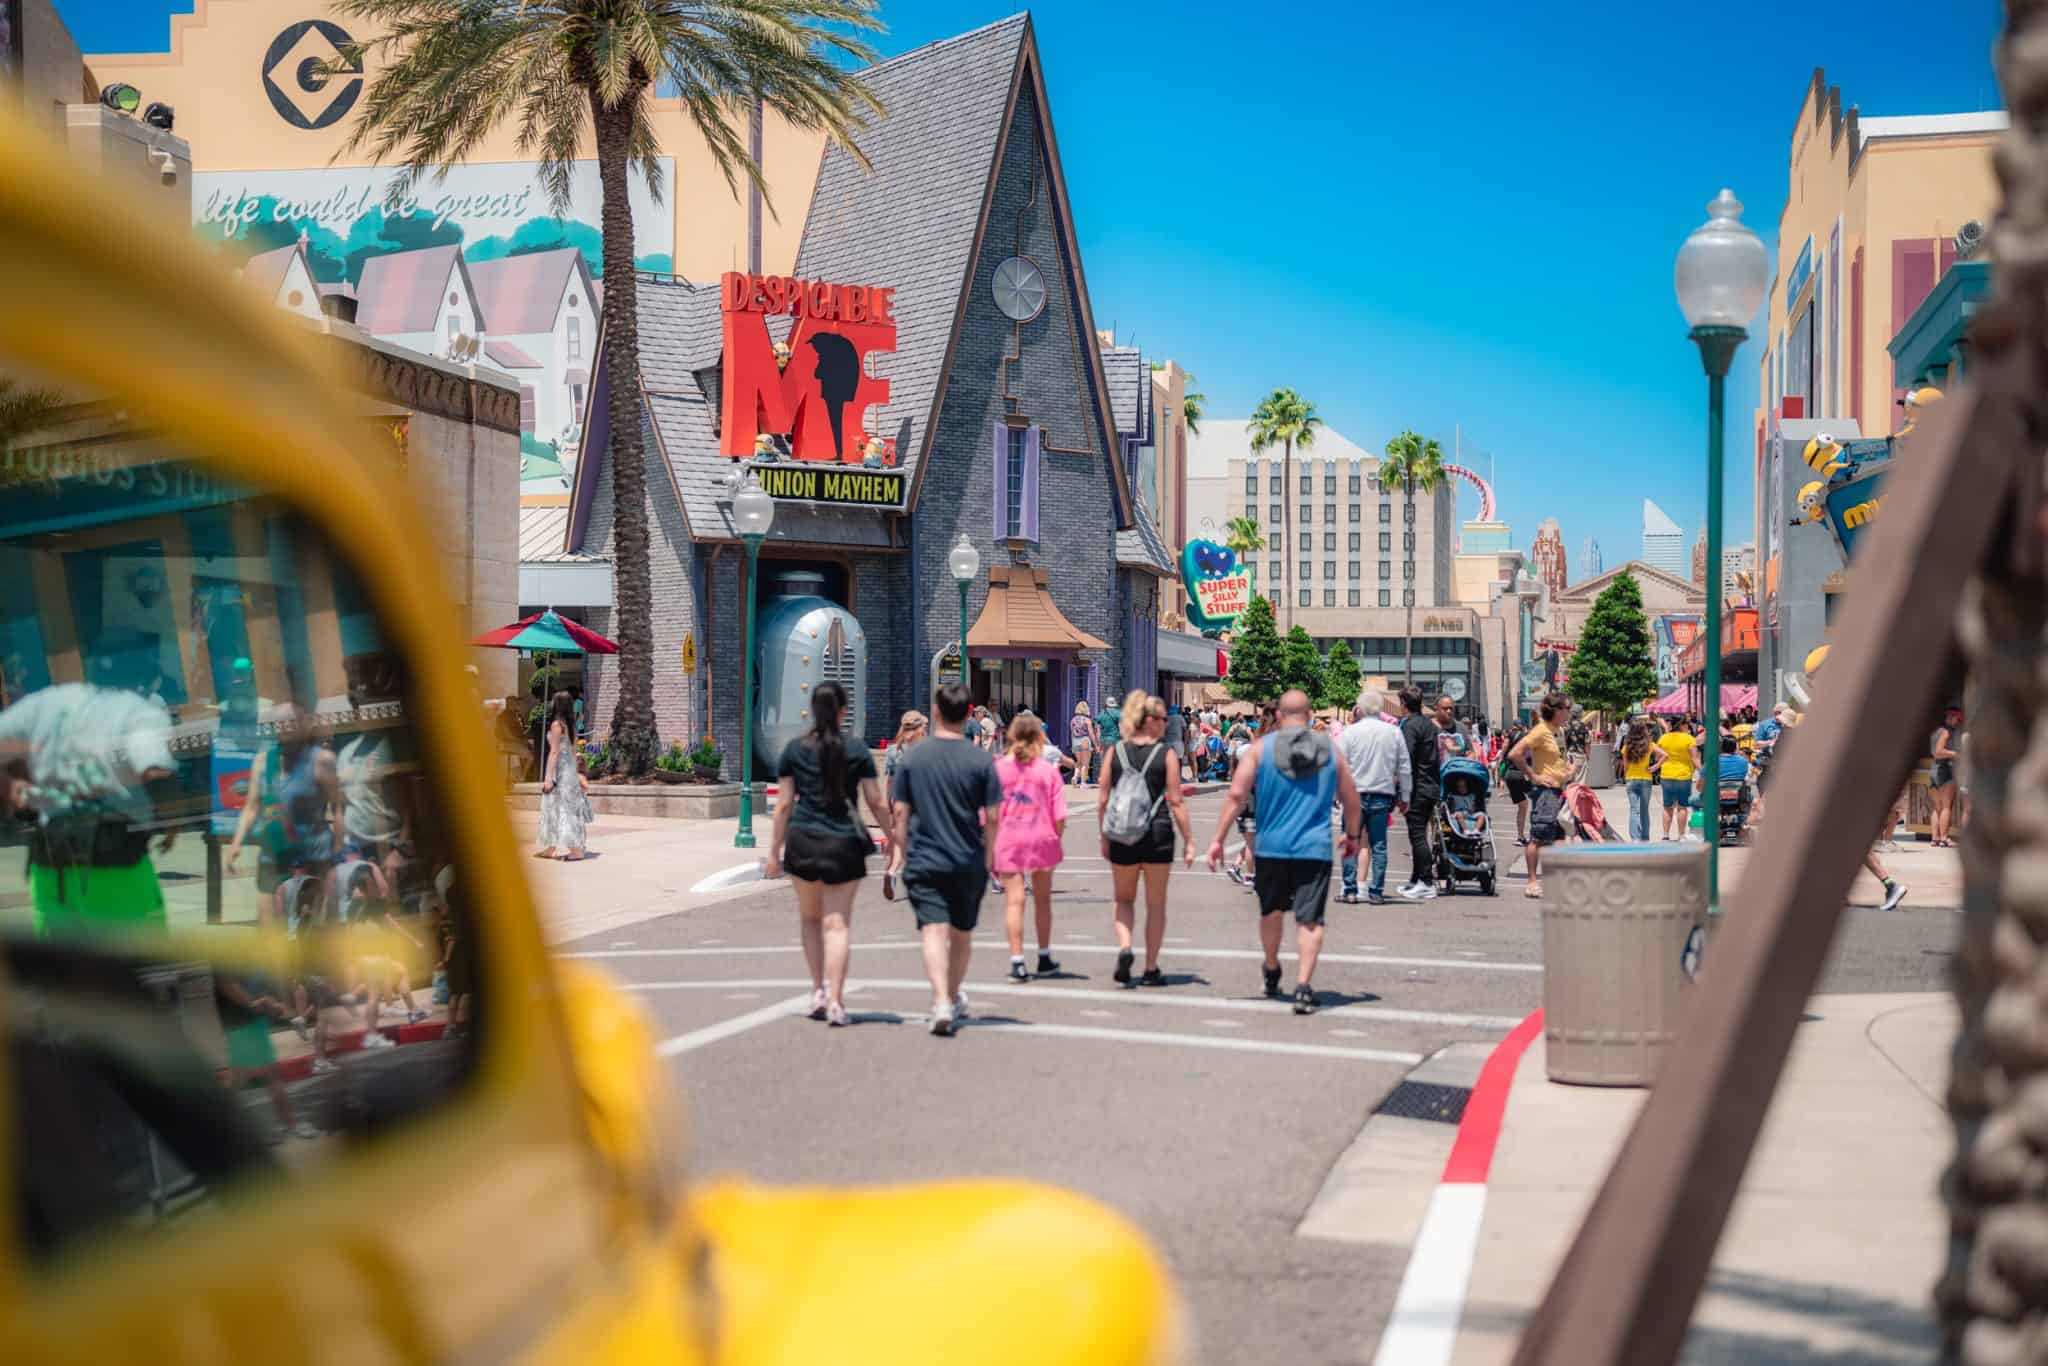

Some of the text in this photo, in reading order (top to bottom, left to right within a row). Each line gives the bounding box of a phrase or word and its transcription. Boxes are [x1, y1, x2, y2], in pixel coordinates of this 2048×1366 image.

[201, 185, 530, 237] life could be great
[722, 272, 896, 324] DESPICABLE
[720, 311, 896, 465] ME
[824, 473, 899, 503] MAYHEM
[1199, 578, 1247, 595] SUPER
[1212, 592, 1238, 603] SILLY
[1206, 602, 1246, 615] STUFF
